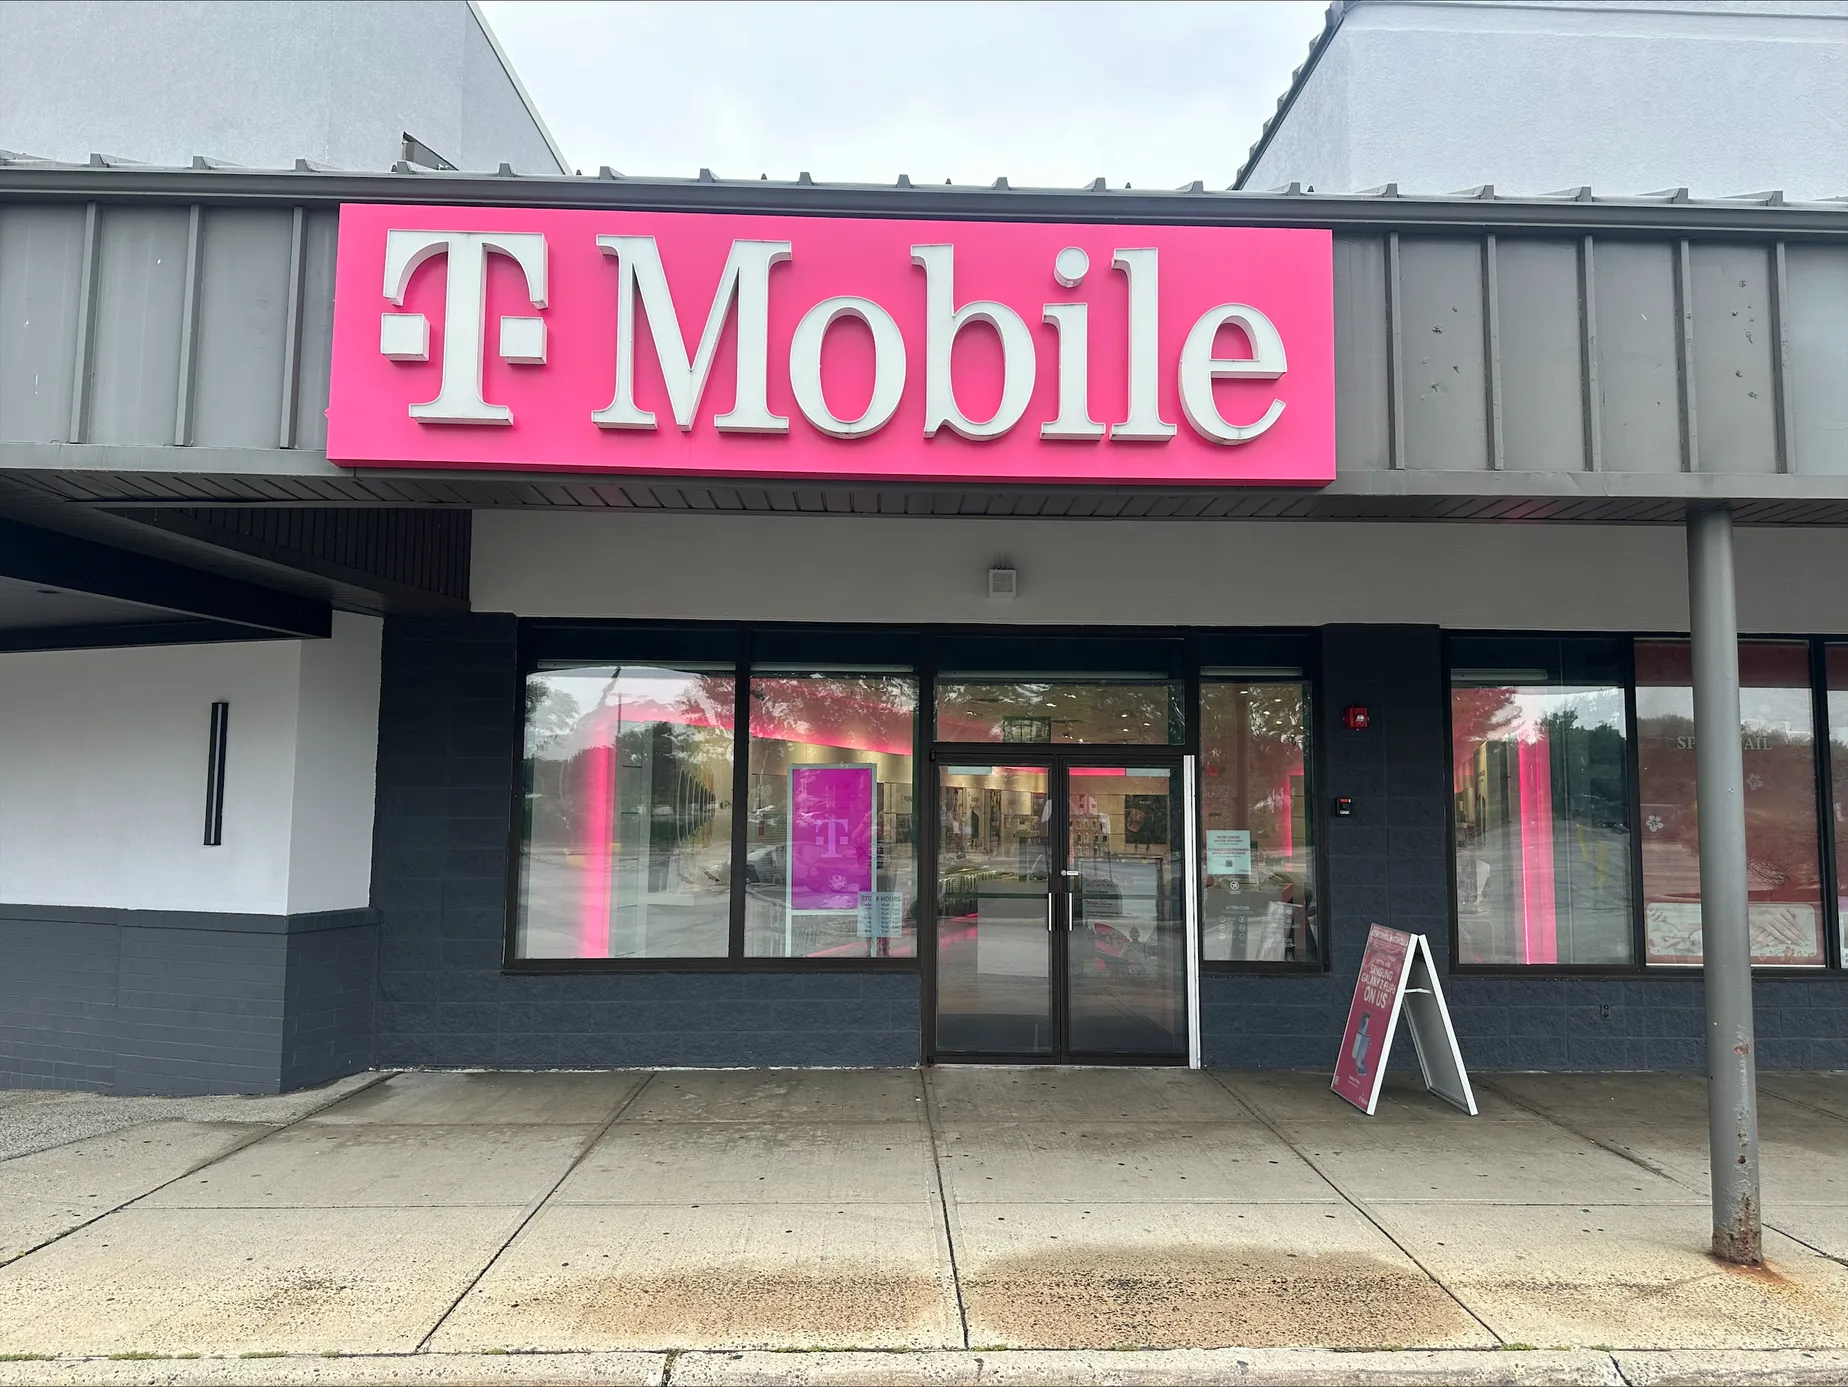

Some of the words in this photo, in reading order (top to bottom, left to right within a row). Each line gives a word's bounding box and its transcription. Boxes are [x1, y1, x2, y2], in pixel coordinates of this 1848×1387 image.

[380, 228, 548, 429] T
[591, 234, 1288, 446] Mobile
[1741, 737, 1772, 751] AIL
[1370, 964, 1394, 981] SAMSUNG
[1361, 973, 1380, 988] GALAXY
[1379, 980, 1385, 990] Z
[1363, 986, 1377, 1004] ON
[1375, 991, 1388, 1009] US
